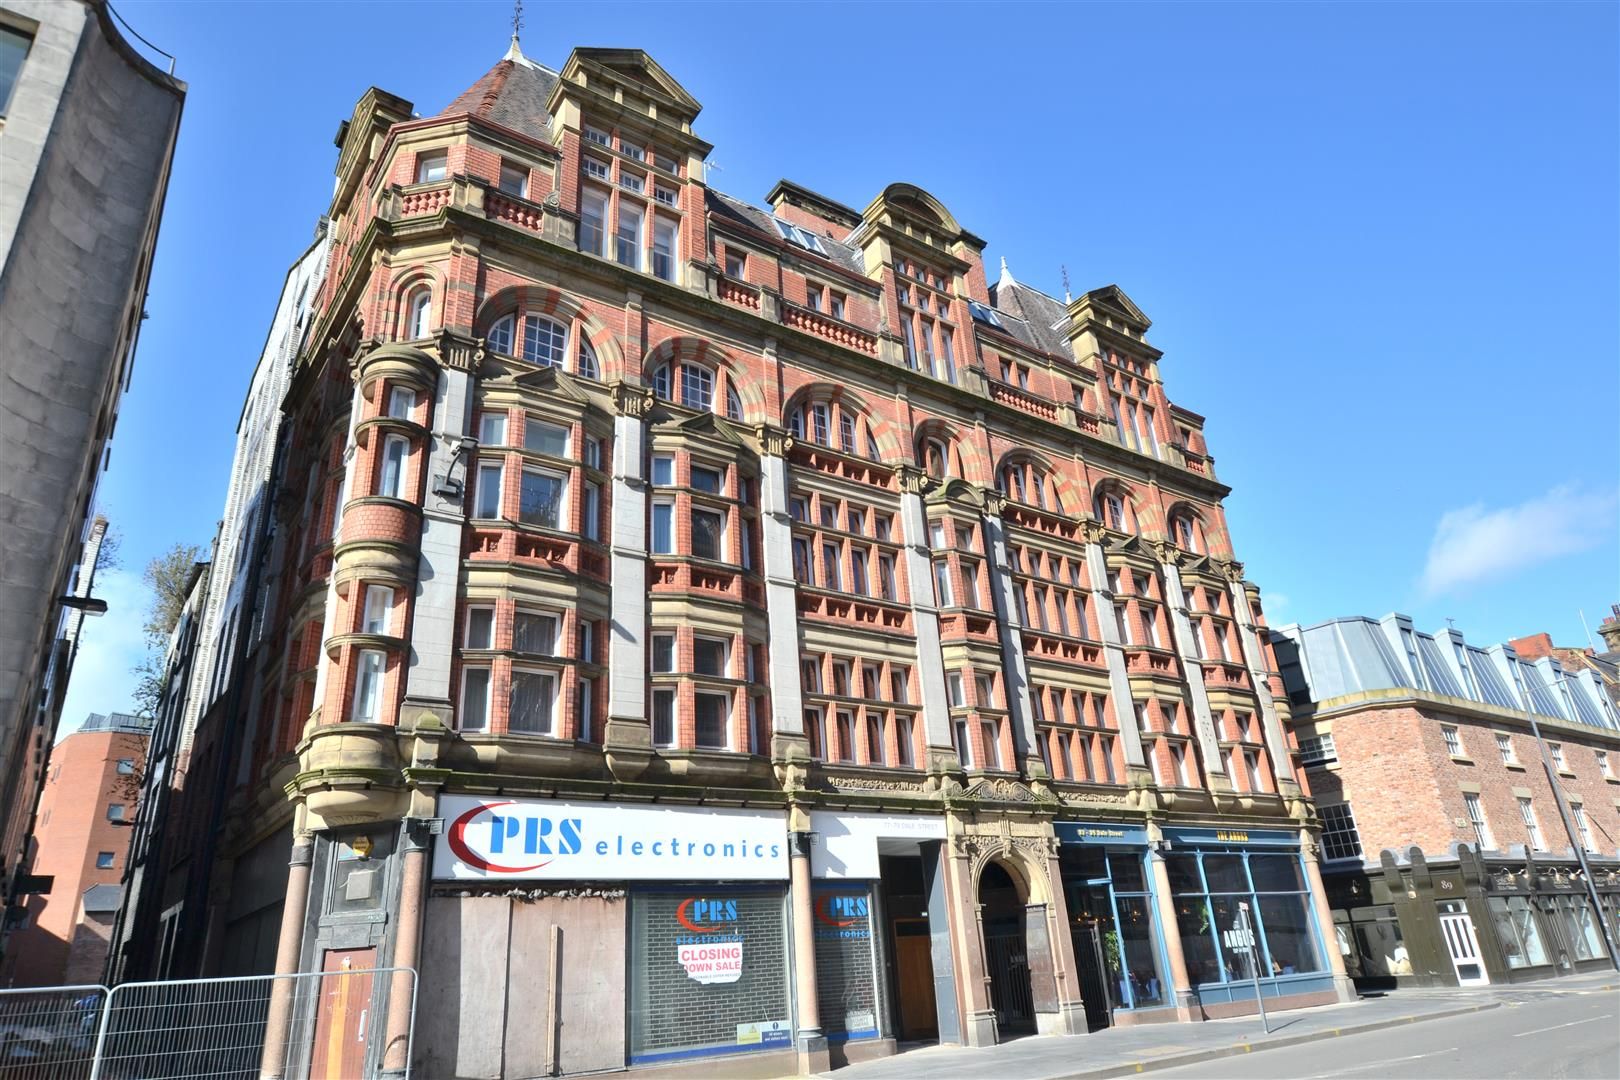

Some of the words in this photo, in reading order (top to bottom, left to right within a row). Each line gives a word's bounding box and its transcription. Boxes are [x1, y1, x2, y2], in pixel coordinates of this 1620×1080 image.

[490, 816, 582, 855] PRS
[595, 835, 779, 858] electronics
[1440, 880, 1453, 890] 89
[693, 900, 737, 922] PRS
[830, 895, 867, 916] PRS
[676, 934, 744, 945] electronics
[681, 948, 740, 961] CLOSING
[716, 961, 740, 970] SALE
